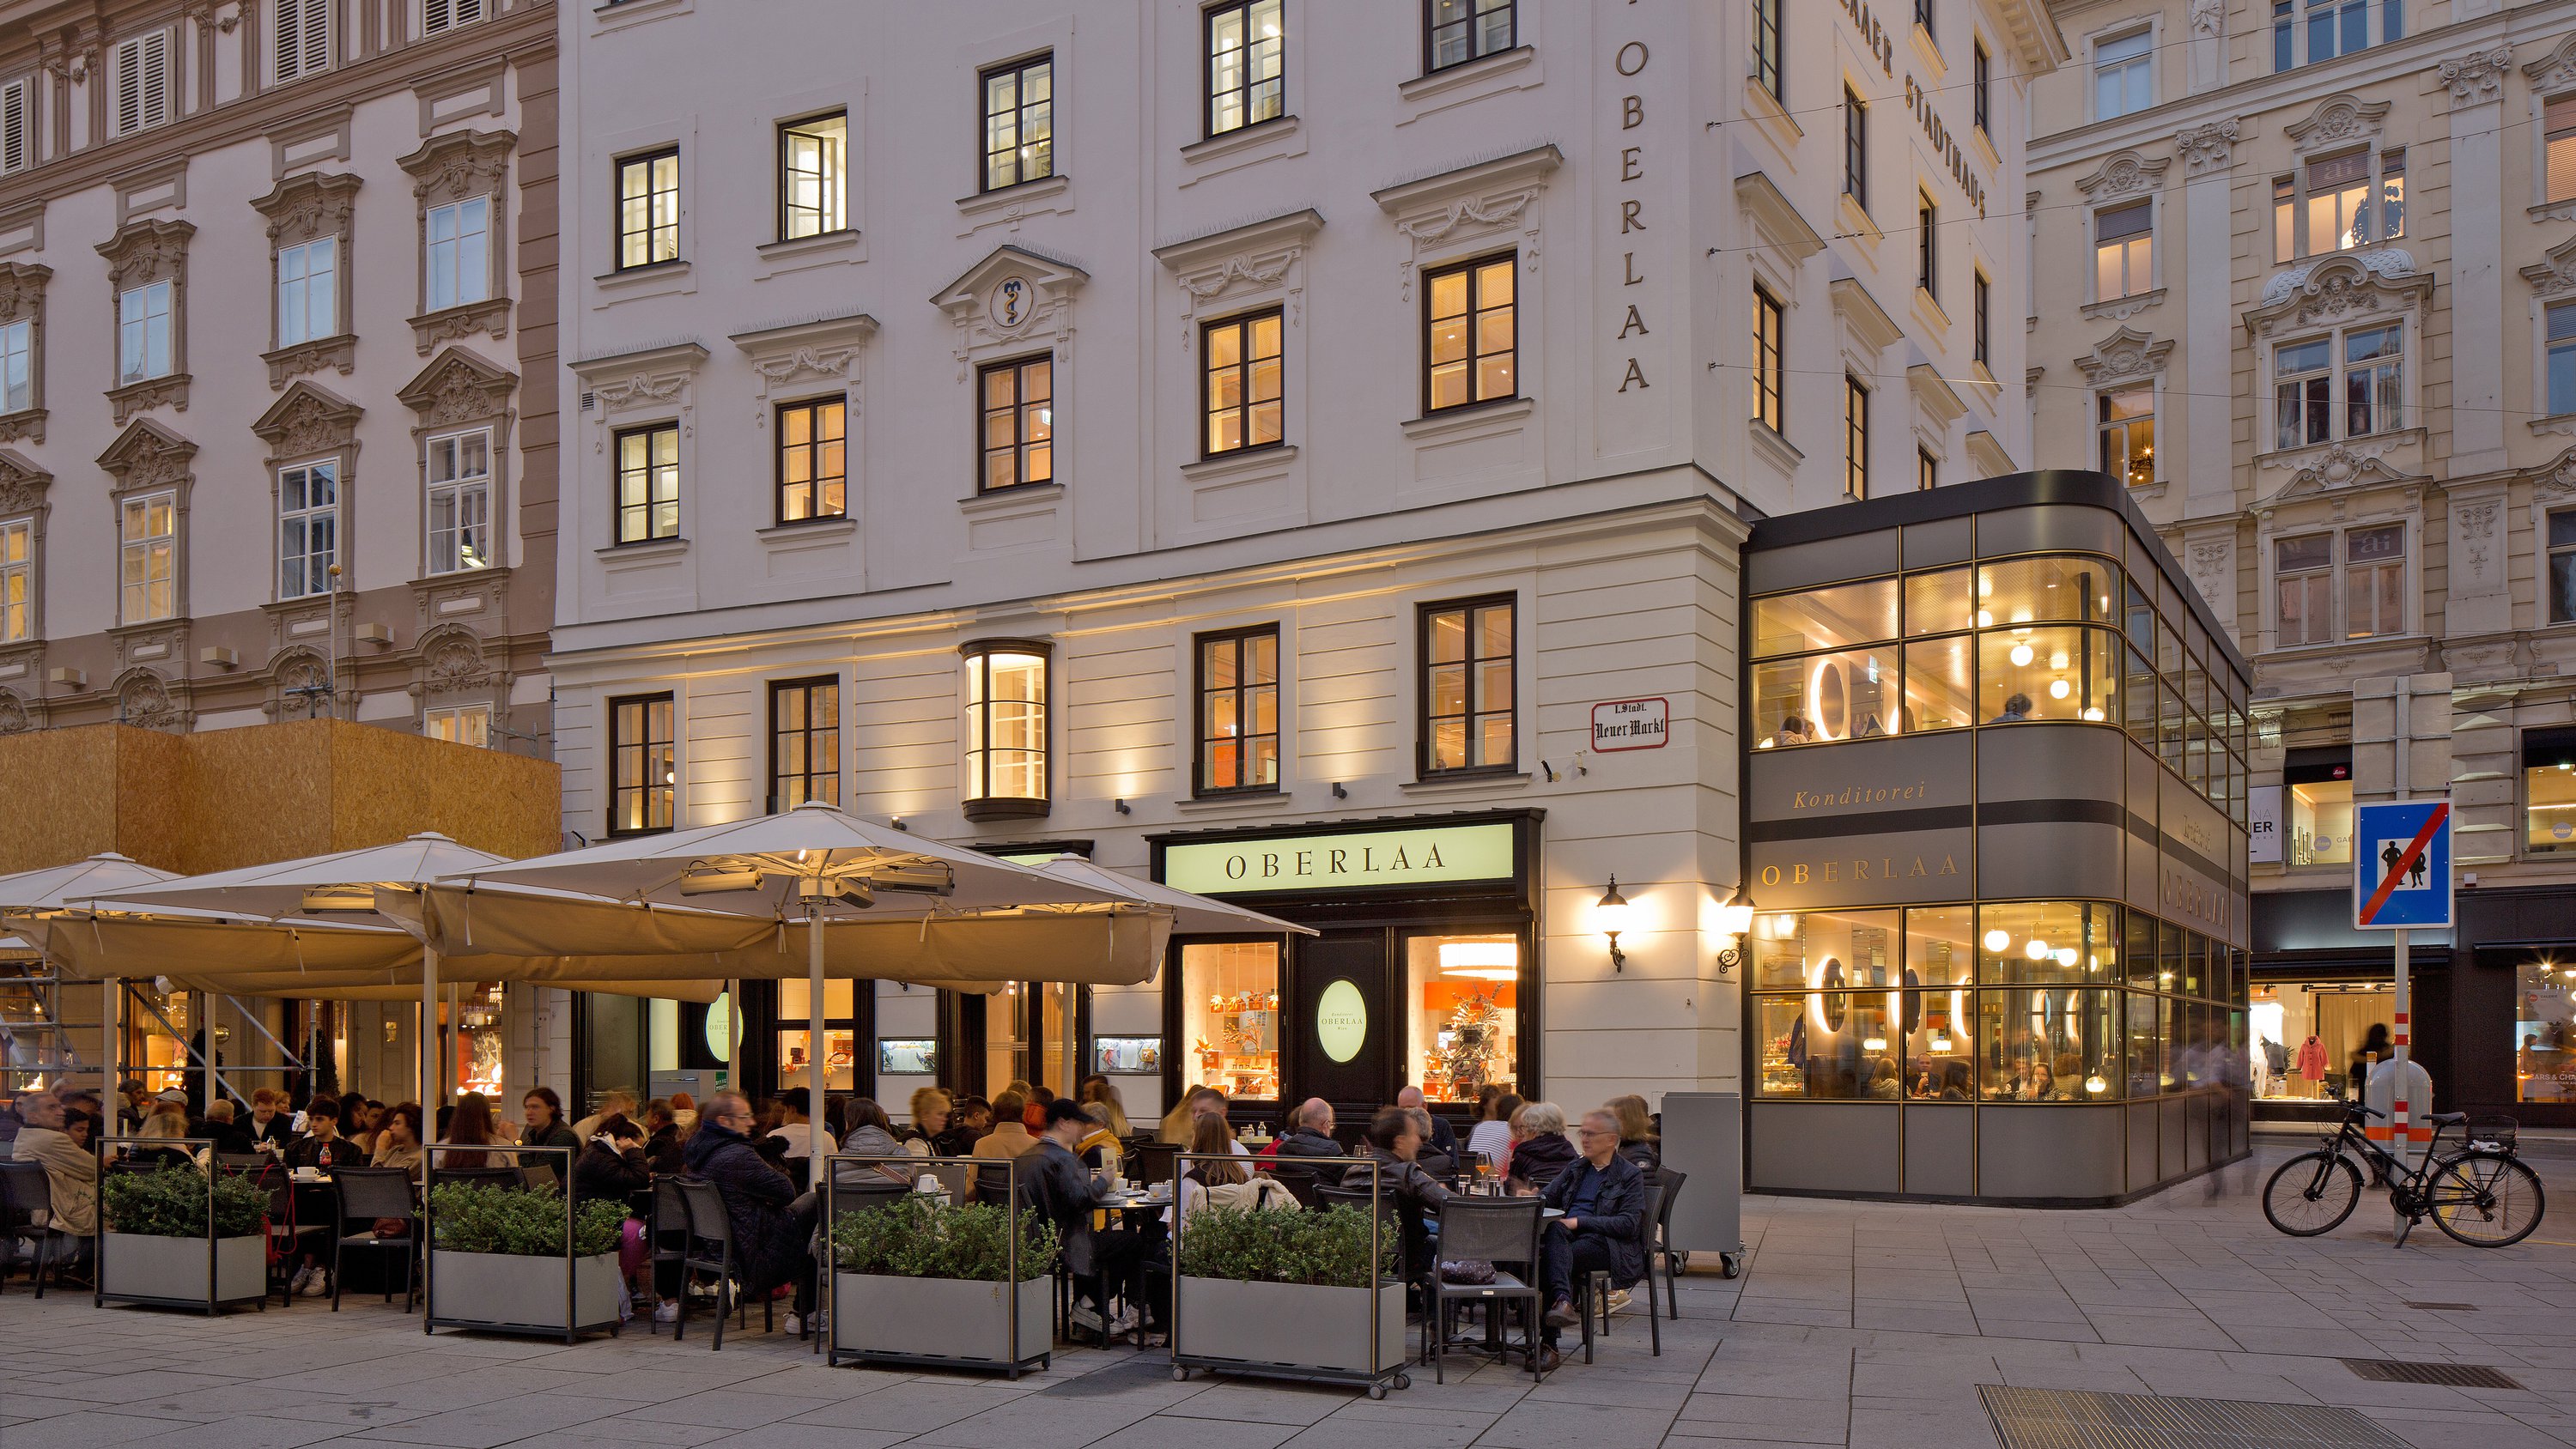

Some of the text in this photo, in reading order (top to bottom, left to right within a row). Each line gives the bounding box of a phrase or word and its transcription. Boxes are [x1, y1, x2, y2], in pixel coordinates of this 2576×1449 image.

[1839, 0, 1985, 220] AAER STADTHAUS
[1615, 40, 1649, 393] OBERLAA
[1595, 718, 1664, 740] Neuer Markt
[1793, 781, 1925, 809] Konditorei
[1225, 842, 1446, 880] OBERLAA
[1762, 853, 1959, 886] OBERLAA
